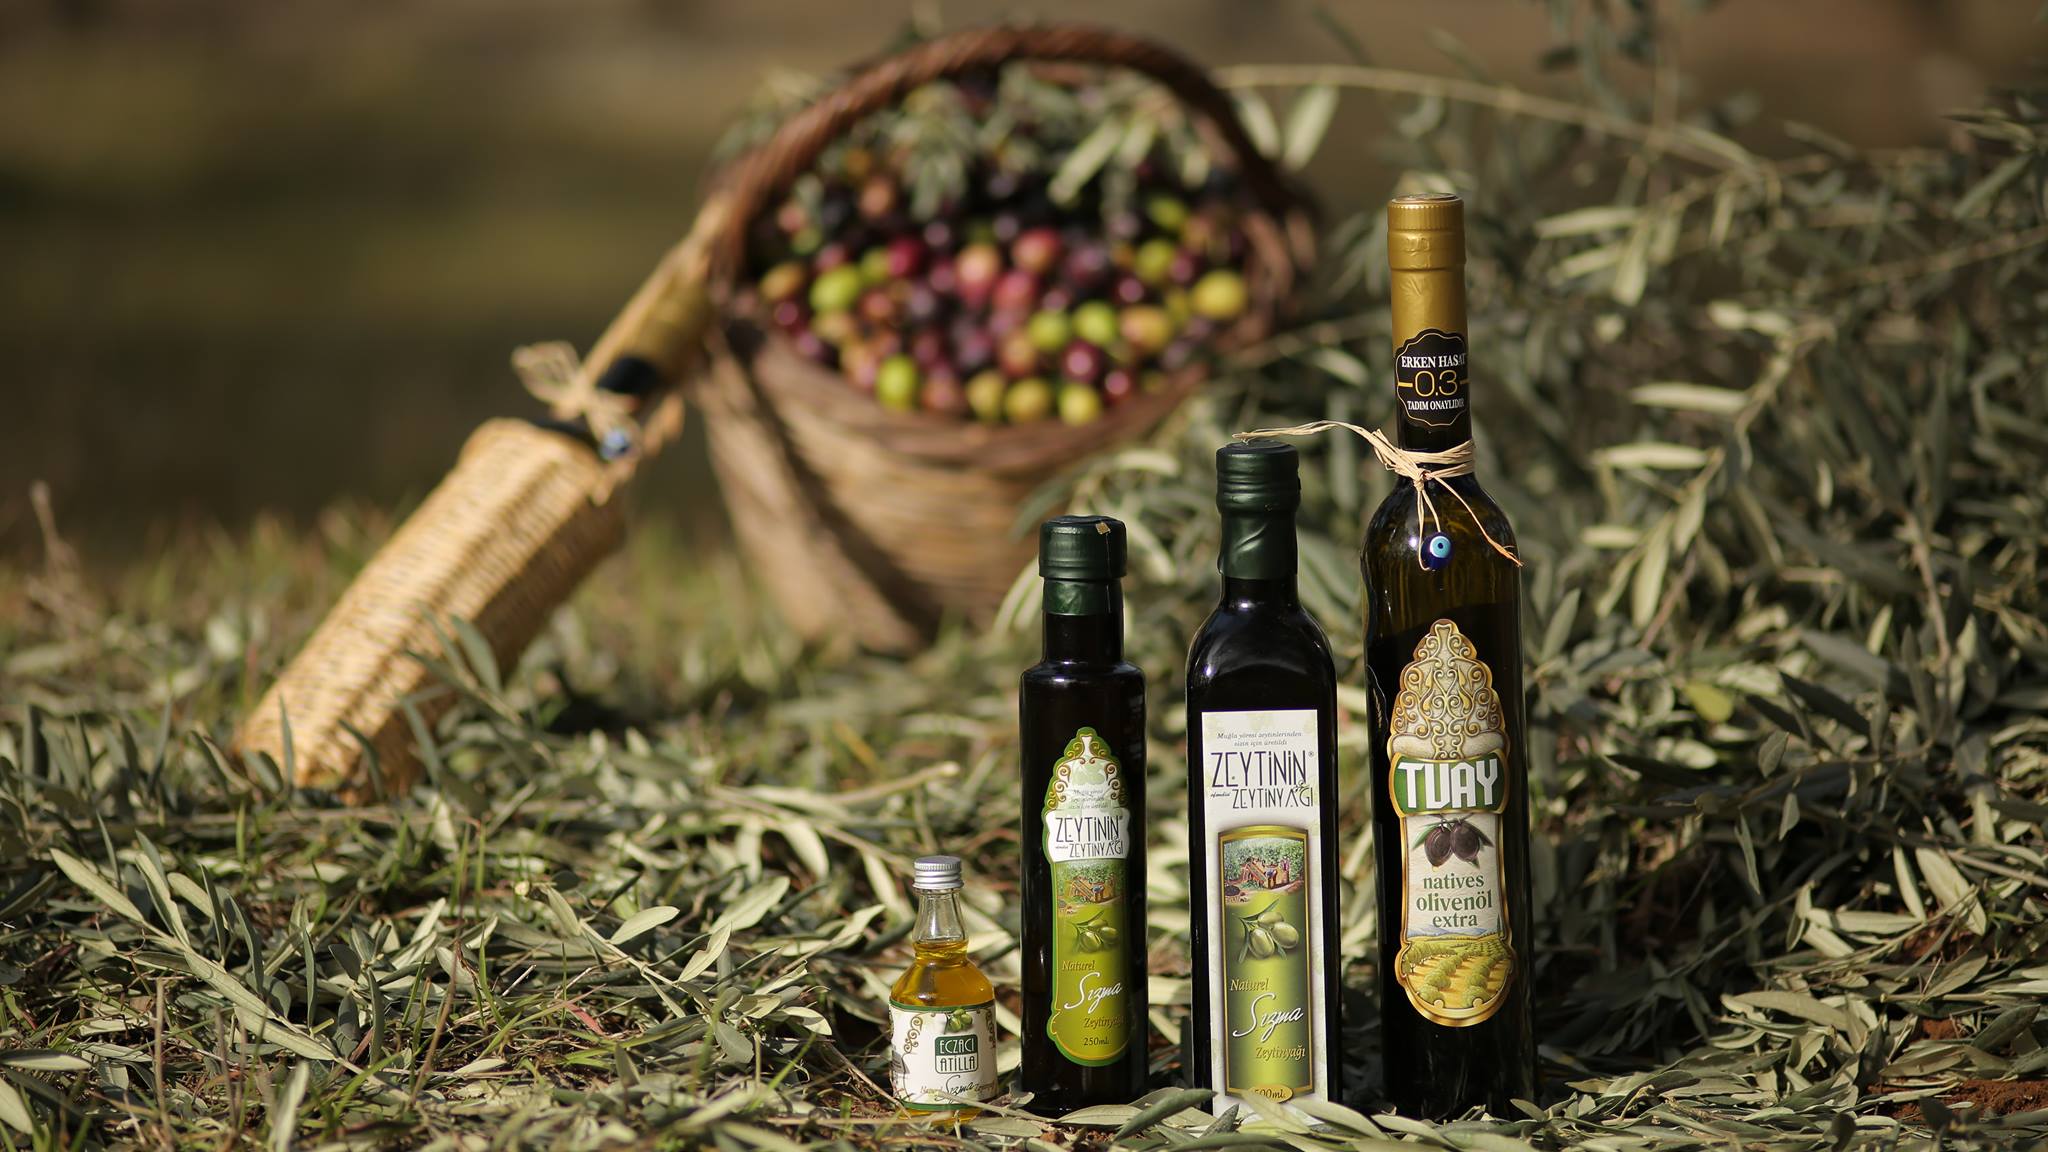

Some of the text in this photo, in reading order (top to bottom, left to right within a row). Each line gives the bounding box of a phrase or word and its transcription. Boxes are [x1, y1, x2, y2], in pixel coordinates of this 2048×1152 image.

[1401, 353, 1466, 368] ERKEN HASAT
[1414, 369, 1458, 397] 0.3
[1407, 398, 1465, 411] TADIM ONAYLIDIR
[1398, 758, 1498, 809] TUAY
[1423, 873, 1485, 890] natives
[1416, 889, 1493, 912] olivenöl
[1432, 914, 1478, 928] extra
[1062, 960, 1096, 972] Naturel
[1230, 978, 1270, 992] Naturel
[939, 1038, 974, 1054] ECZACI
[1255, 1045, 1306, 1062] Zeytinyağı
[940, 1054, 975, 1072] ATİLLA
